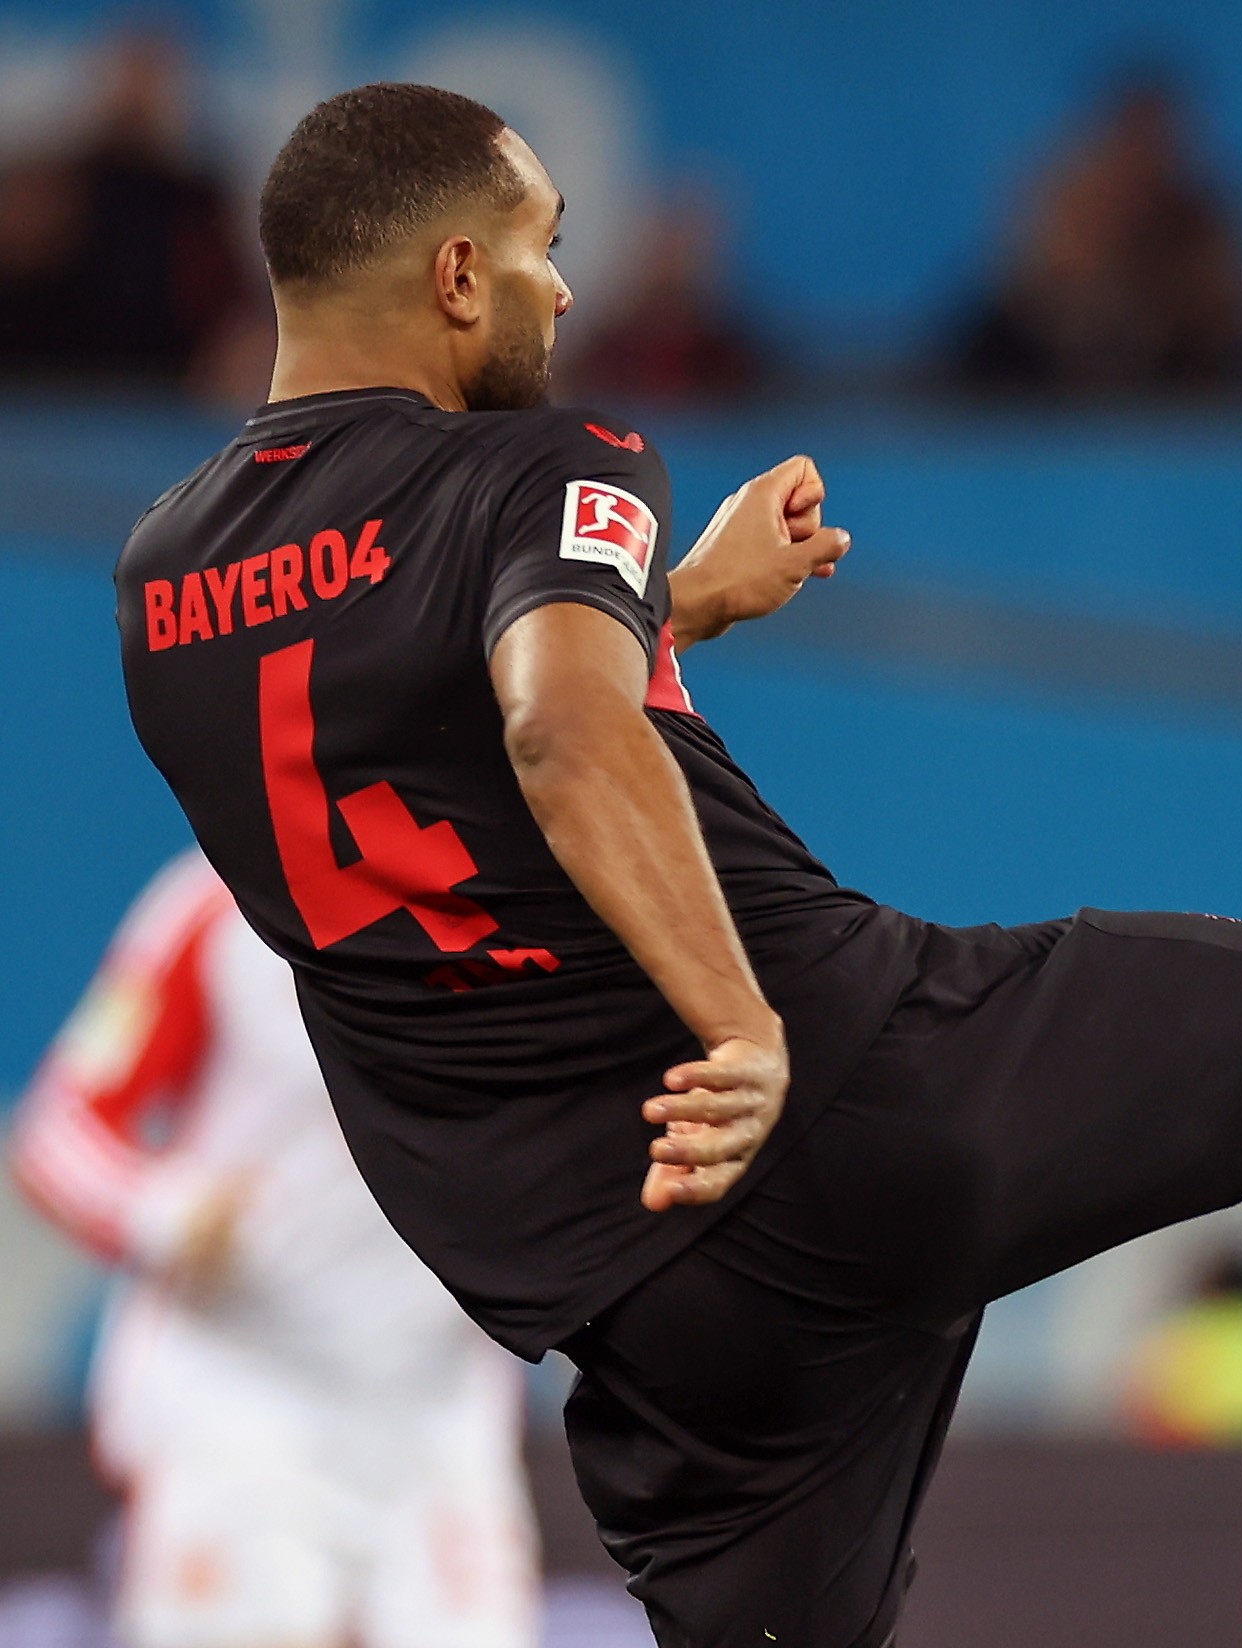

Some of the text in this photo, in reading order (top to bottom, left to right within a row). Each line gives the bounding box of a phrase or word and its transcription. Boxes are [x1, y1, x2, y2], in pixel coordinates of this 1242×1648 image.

[144, 519, 393, 652] BAYER 04
[258, 638, 500, 953] 4
